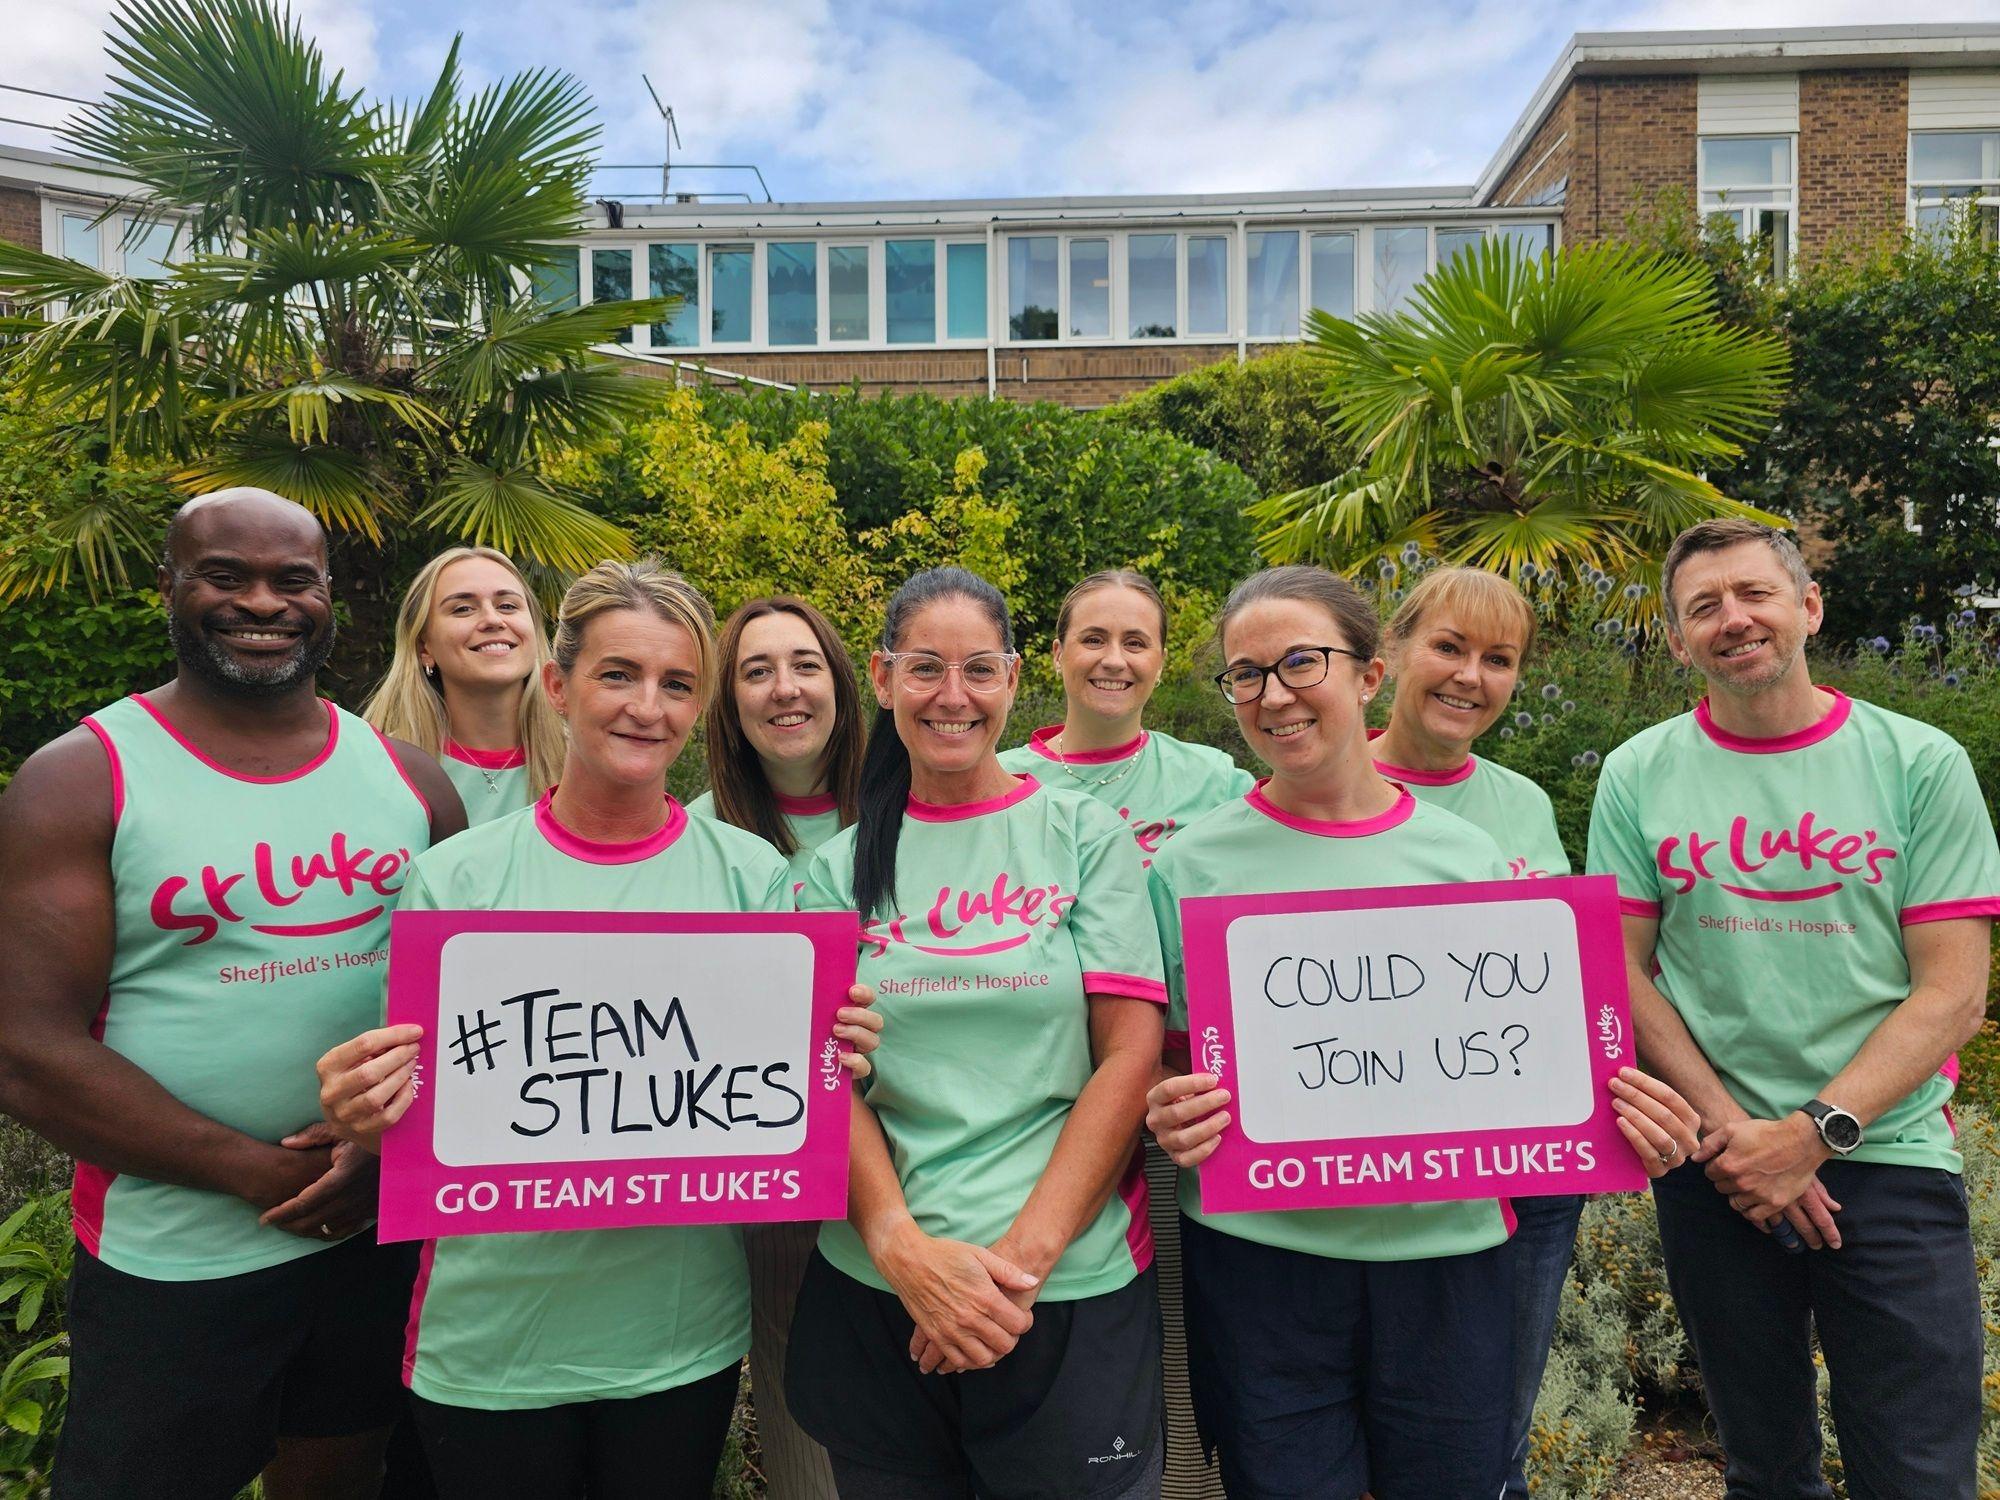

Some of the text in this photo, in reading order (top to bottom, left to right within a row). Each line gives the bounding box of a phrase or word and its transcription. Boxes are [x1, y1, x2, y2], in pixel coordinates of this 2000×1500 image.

[1656, 811, 1897, 895] St Luke's
[150, 832, 412, 946] St Luke'
[927, 872, 1077, 939] Luke's
[1698, 914, 1857, 936] Sheffield's Hospice
[219, 947, 390, 984] Sheffield's Hospic
[878, 971, 1049, 998] Sheffield's Hospice
[1264, 951, 1551, 1009] COULD YOU
[448, 988, 700, 1075] #TEAM
[1292, 1024, 1530, 1091] JOIN US?
[435, 1169, 801, 1214] GO TEAM ST LUKE'S
[1248, 1141, 1597, 1190] GO TEAM ST LUKE'S
